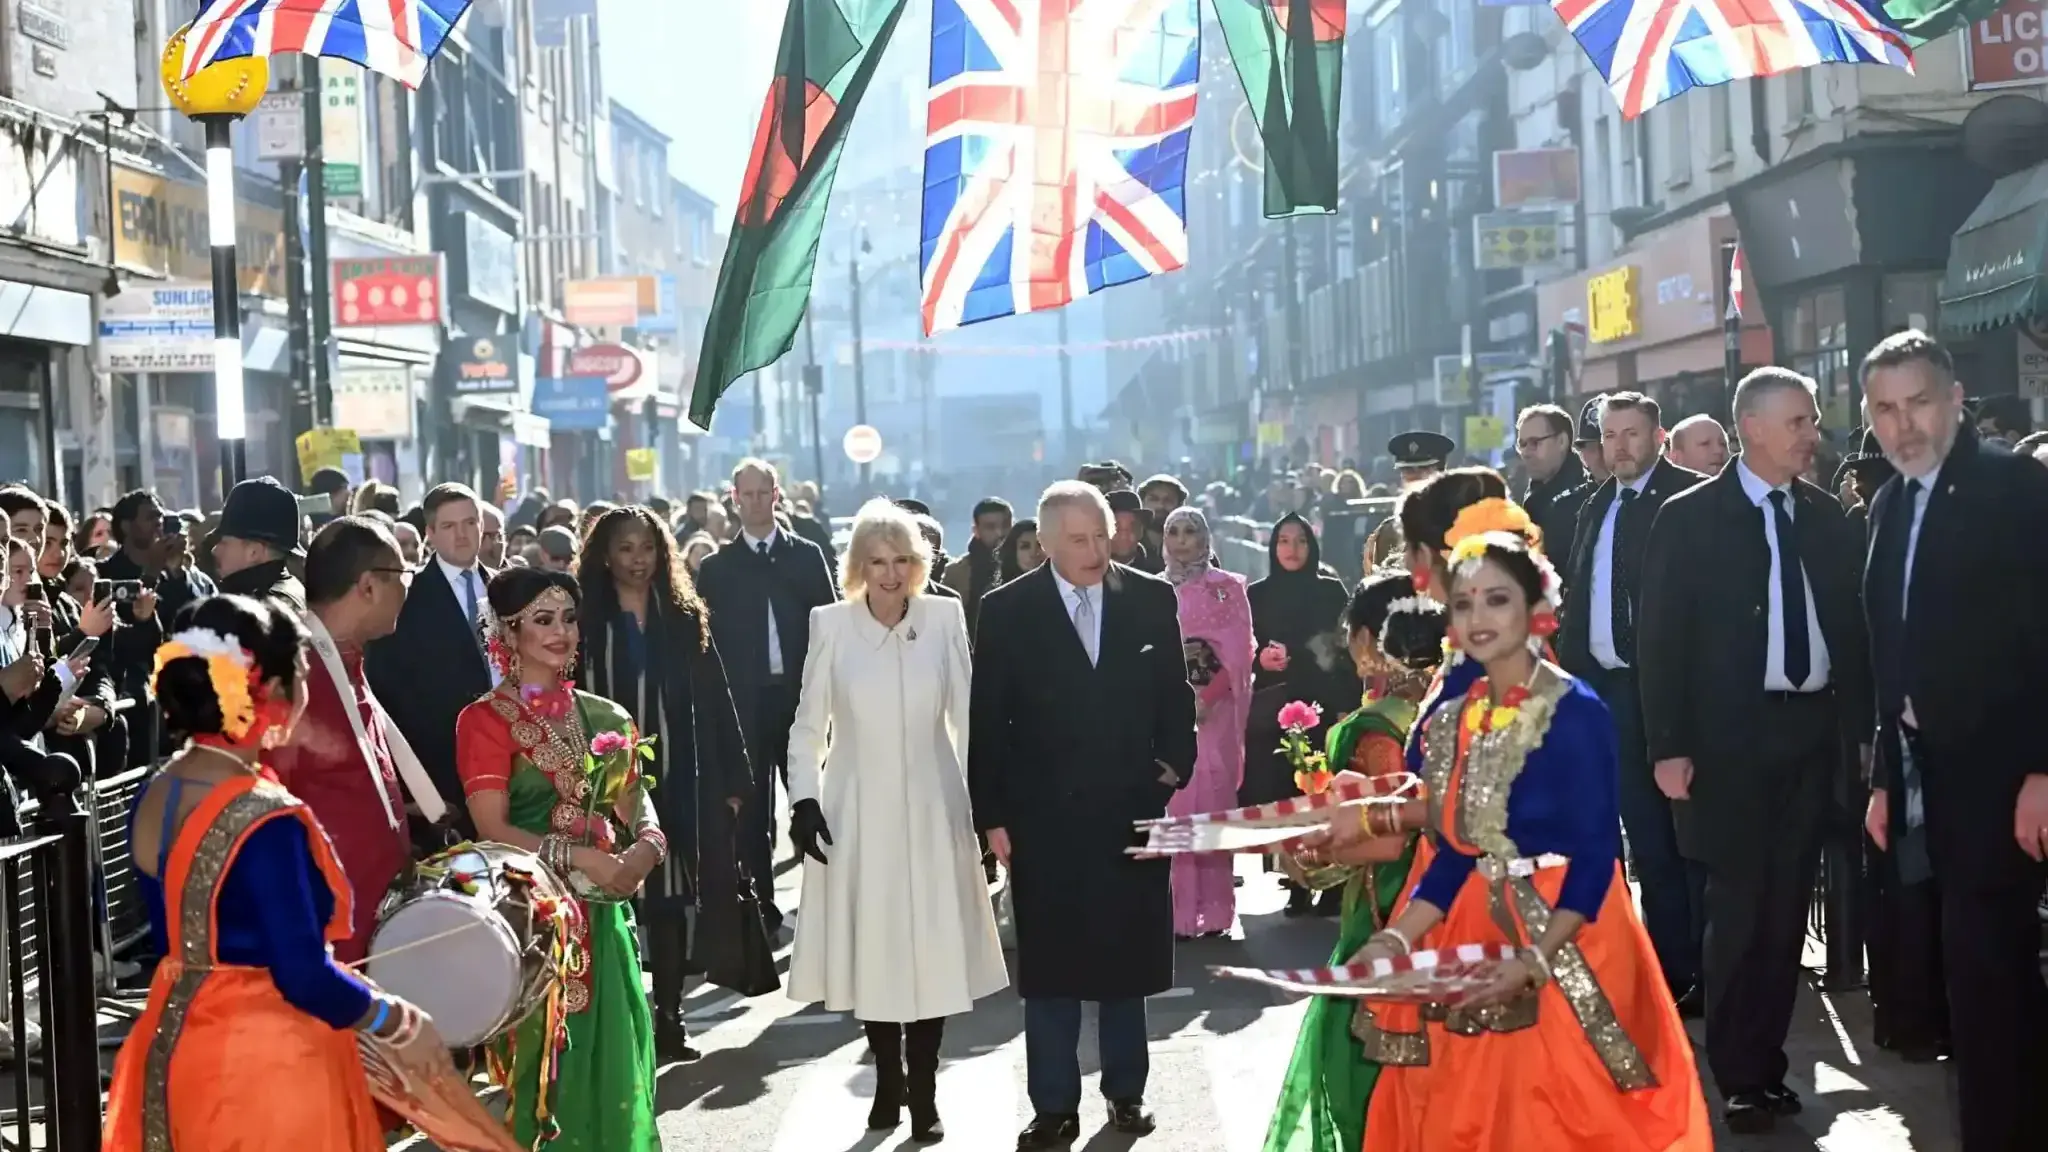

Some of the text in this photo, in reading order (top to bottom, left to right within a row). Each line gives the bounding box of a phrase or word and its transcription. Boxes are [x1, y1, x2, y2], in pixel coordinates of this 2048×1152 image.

[1981, 10, 2048, 45] LIC
[2014, 46, 2048, 73] O
[153, 290, 213, 305] SUNLIGH
